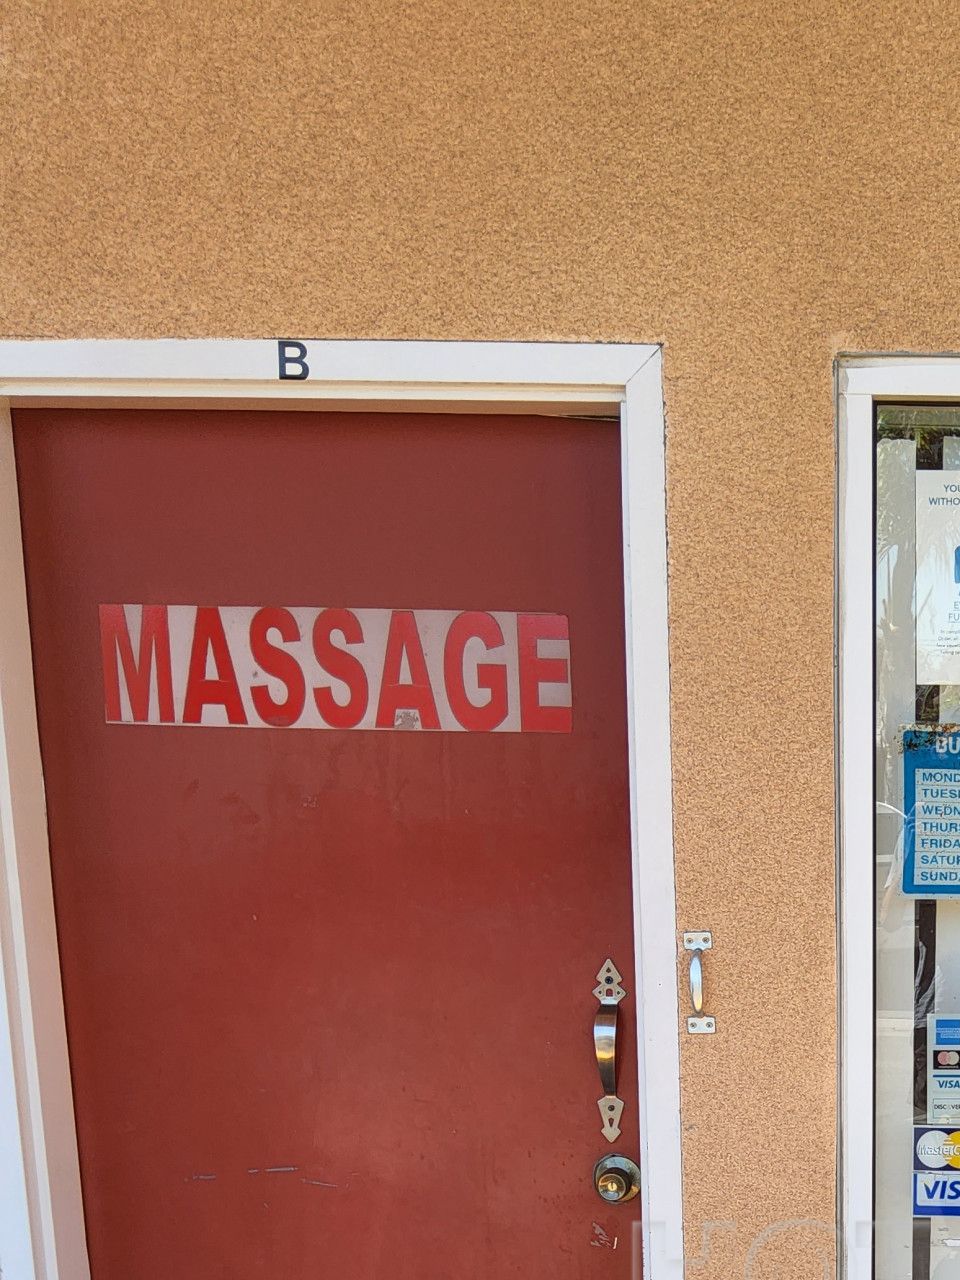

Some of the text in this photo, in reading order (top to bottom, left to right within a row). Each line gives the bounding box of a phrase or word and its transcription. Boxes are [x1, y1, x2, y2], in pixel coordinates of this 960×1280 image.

[278, 340, 310, 380] B
[98, 602, 573, 732] MASSAGE
[937, 1079, 960, 1089] VISA
